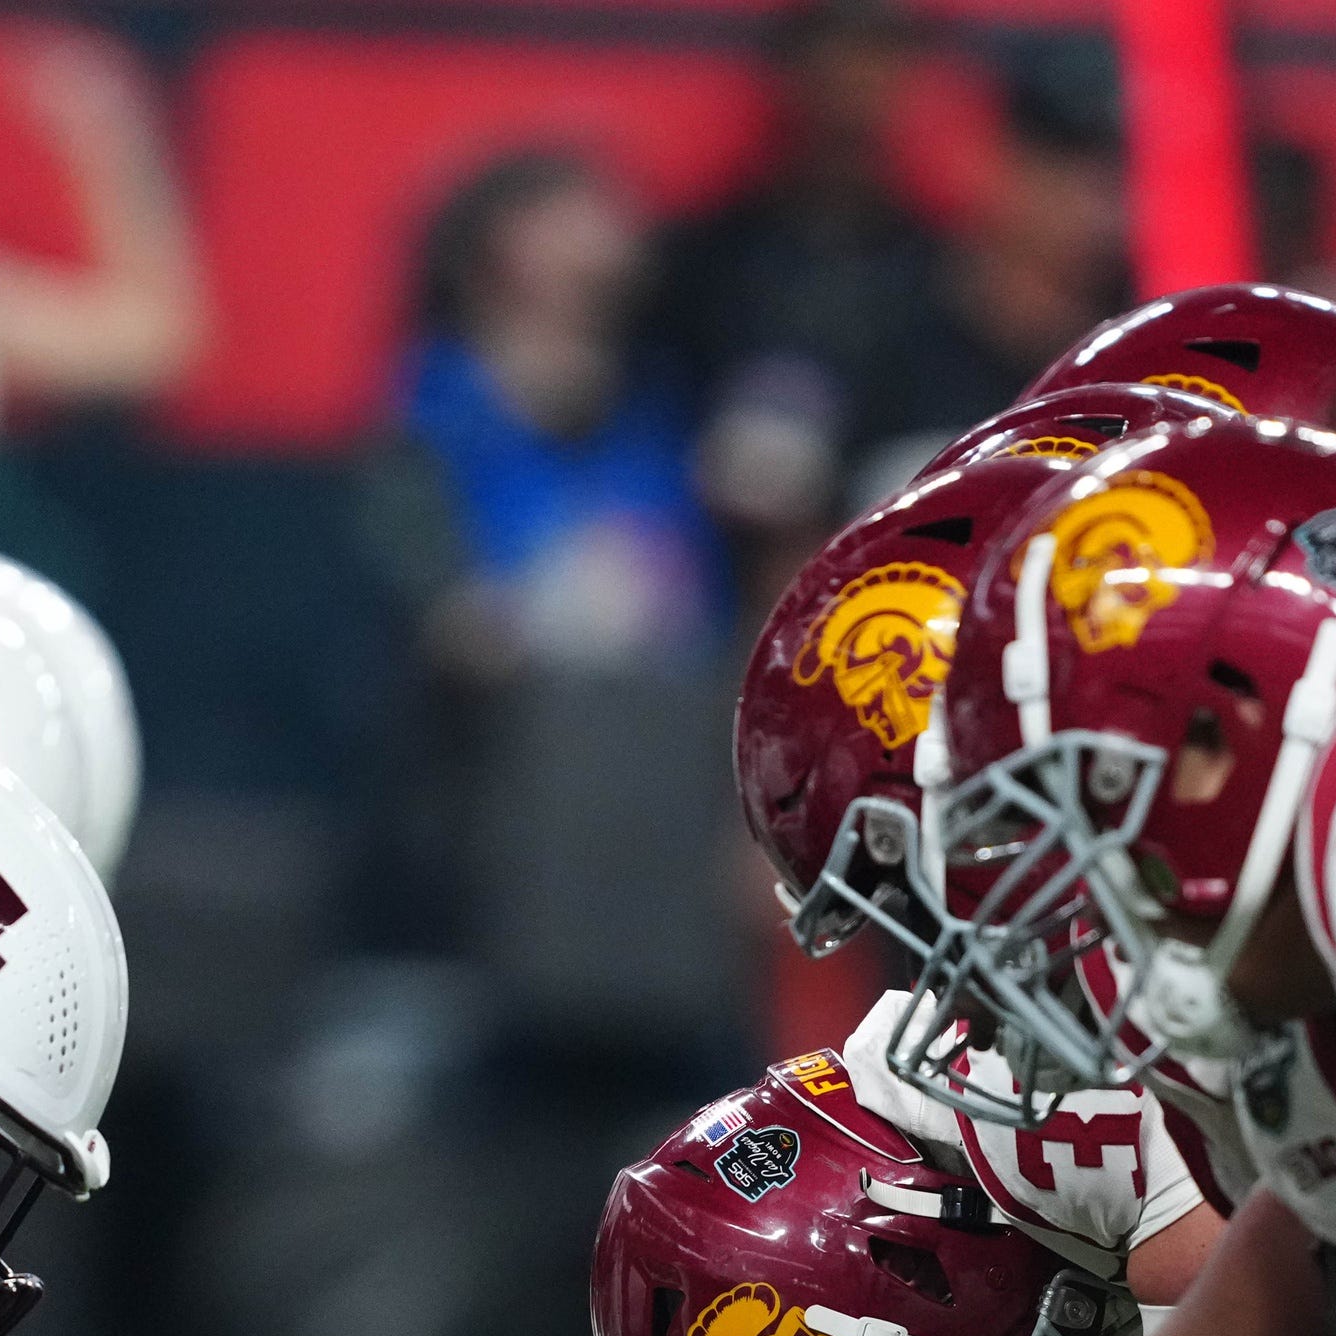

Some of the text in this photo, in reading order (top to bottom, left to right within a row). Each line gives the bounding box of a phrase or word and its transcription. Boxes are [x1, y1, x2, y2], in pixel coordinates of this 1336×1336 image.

[740, 1137, 768, 1166] Vegas
[765, 1142, 782, 1159] BOWL
[728, 1162, 754, 1187] SRS
[761, 1160, 789, 1177] Las
